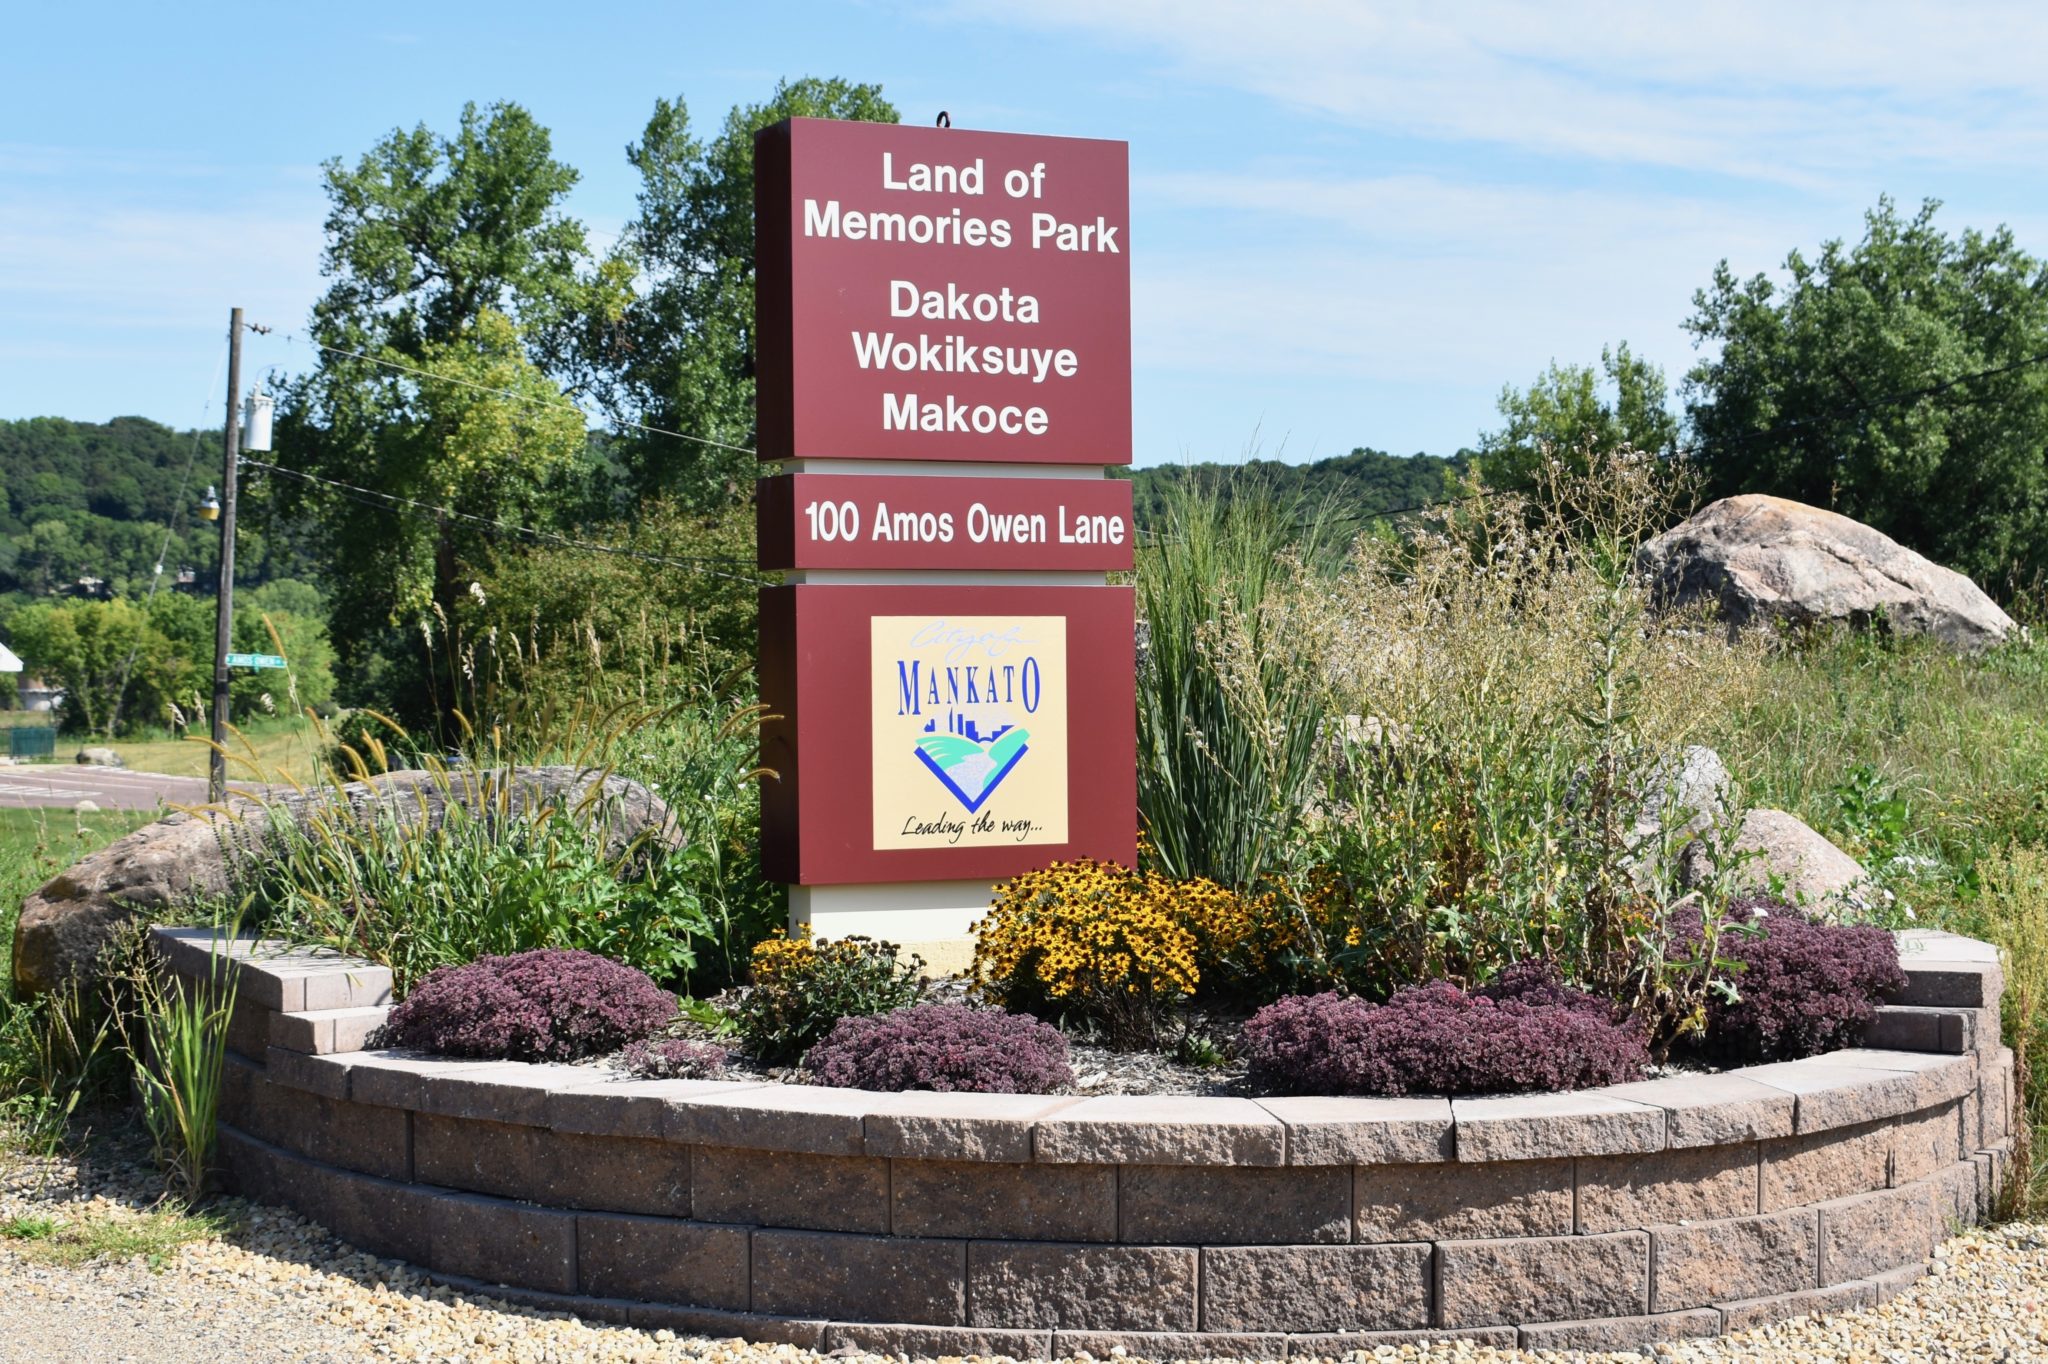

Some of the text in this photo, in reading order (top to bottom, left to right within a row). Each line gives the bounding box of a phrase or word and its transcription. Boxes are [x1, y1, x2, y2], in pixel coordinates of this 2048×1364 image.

[883, 152, 1046, 199] Land of
[804, 199, 1120, 253] Memories Park
[890, 280, 1040, 323] Dakota
[851, 331, 1078, 383] Wokiksuye
[883, 393, 1049, 435] Makoce
[805, 500, 1125, 545] 100 Amos Owen Lane
[897, 656, 1041, 716] MANKATO
[901, 810, 1043, 844] Leading the way...
